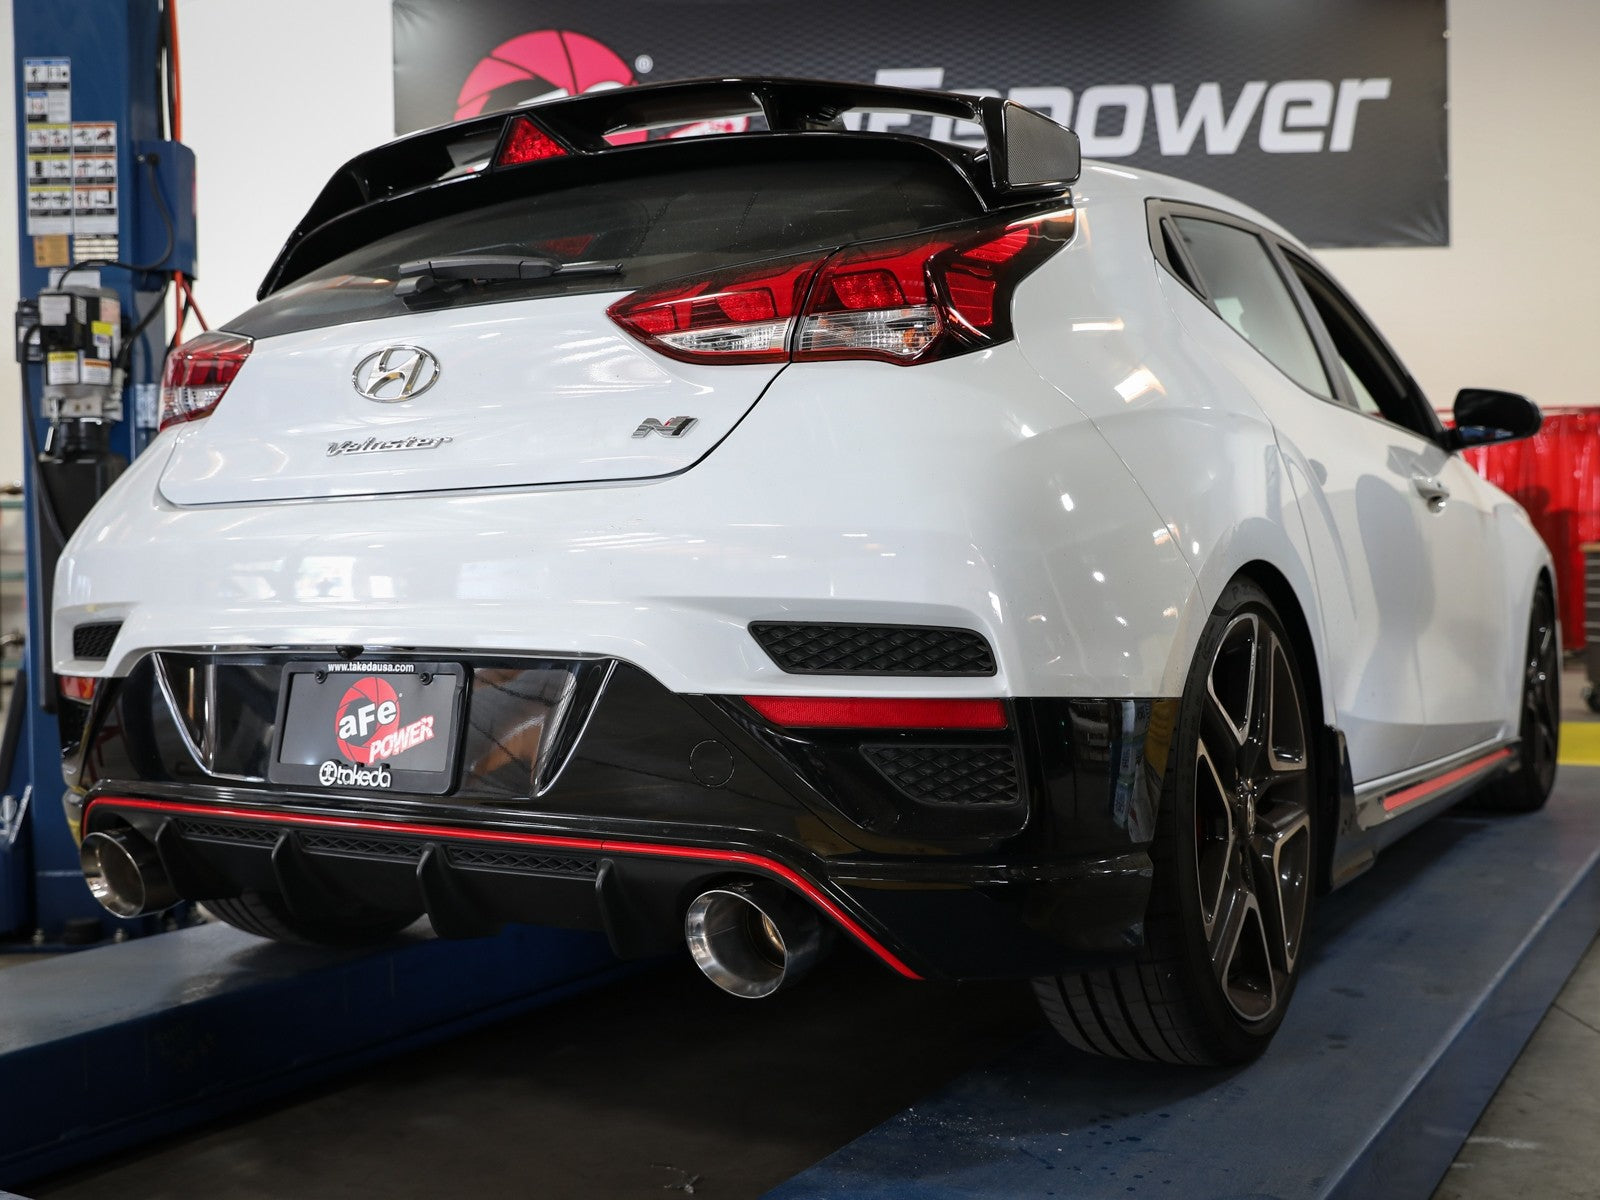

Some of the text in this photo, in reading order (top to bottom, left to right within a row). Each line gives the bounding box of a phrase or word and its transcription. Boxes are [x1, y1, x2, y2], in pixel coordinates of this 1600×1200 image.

[327, 661, 415, 673] www.takedausa.com
[338, 700, 398, 740] aFe
[368, 715, 436, 766] POWER
[337, 763, 392, 788] takeda
